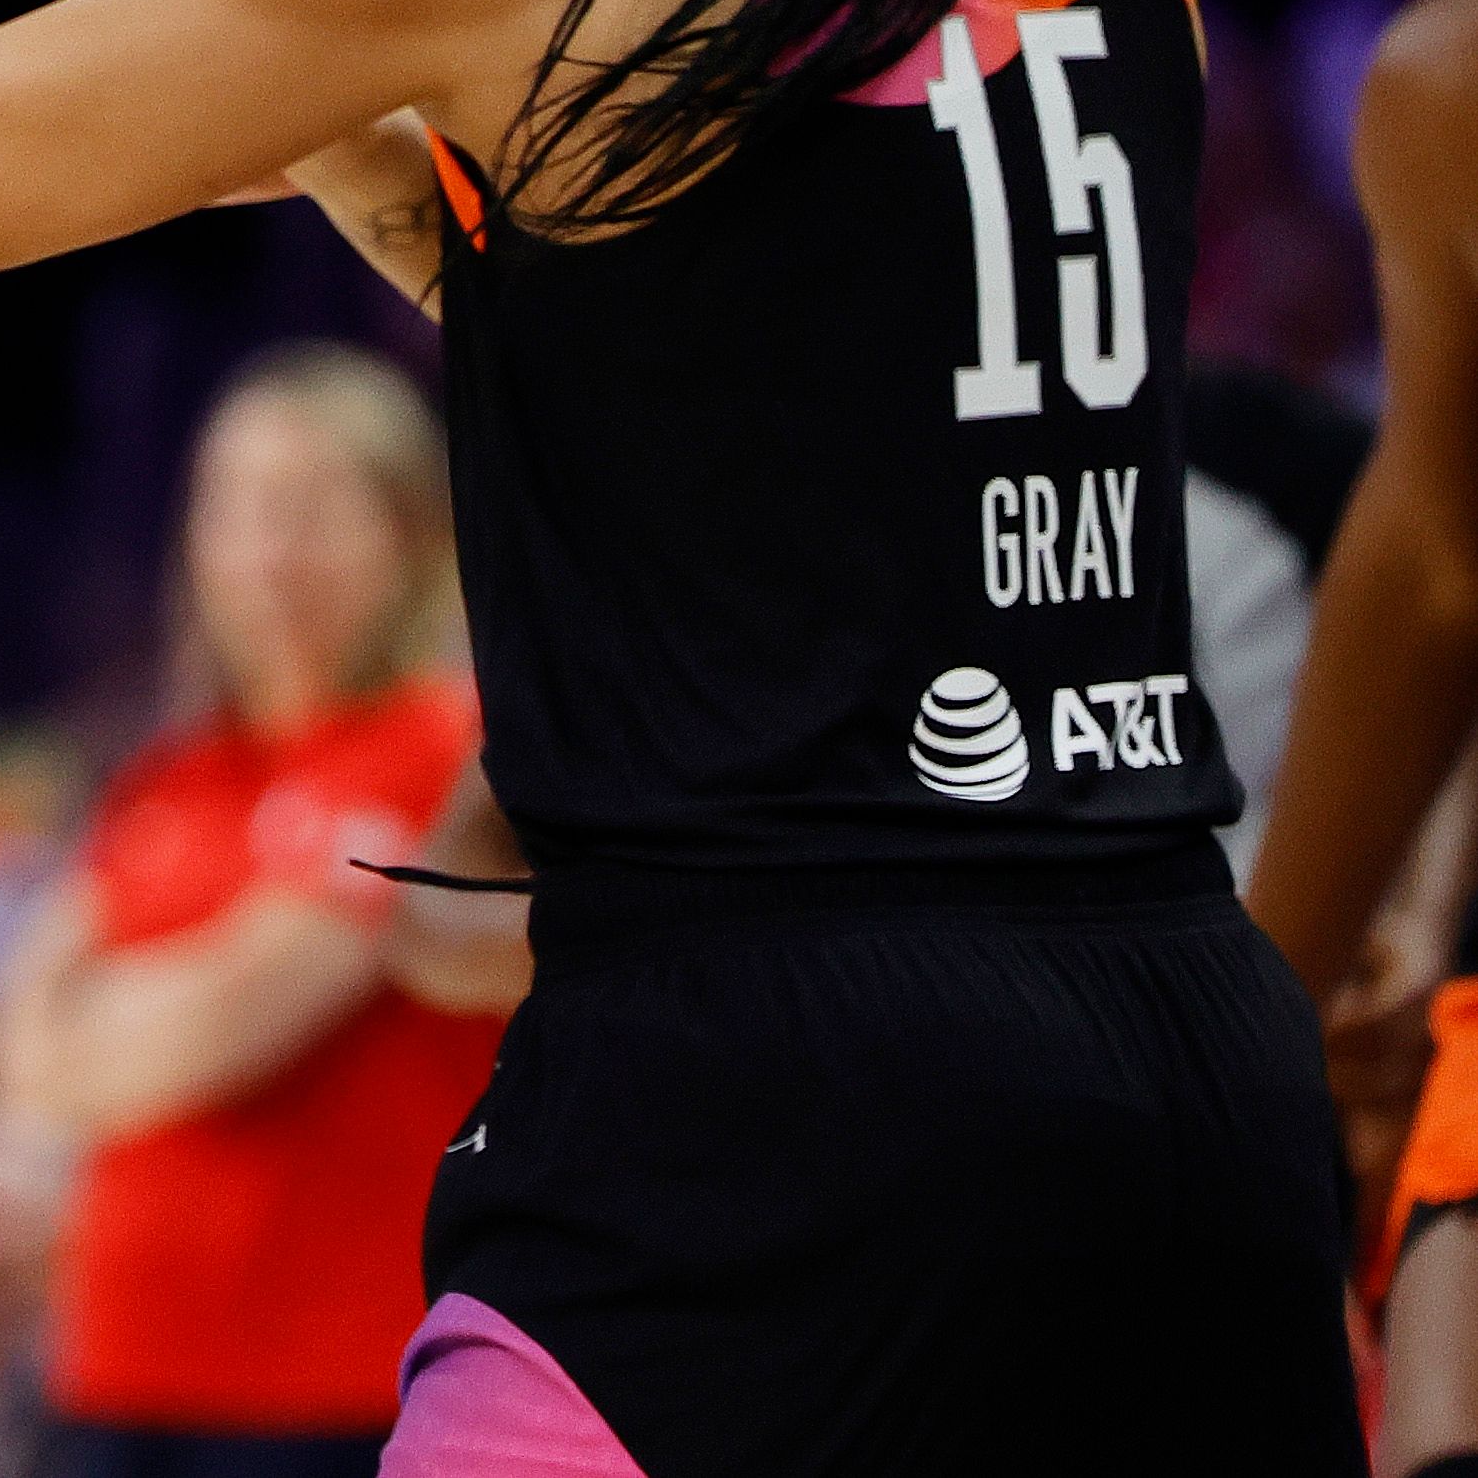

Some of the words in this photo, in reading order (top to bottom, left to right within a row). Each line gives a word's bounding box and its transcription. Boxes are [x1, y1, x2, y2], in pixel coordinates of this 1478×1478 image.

[925, 8, 1147, 420] 15
[982, 466, 1139, 609] GRAY
[1051, 674, 1189, 772] AT&T
